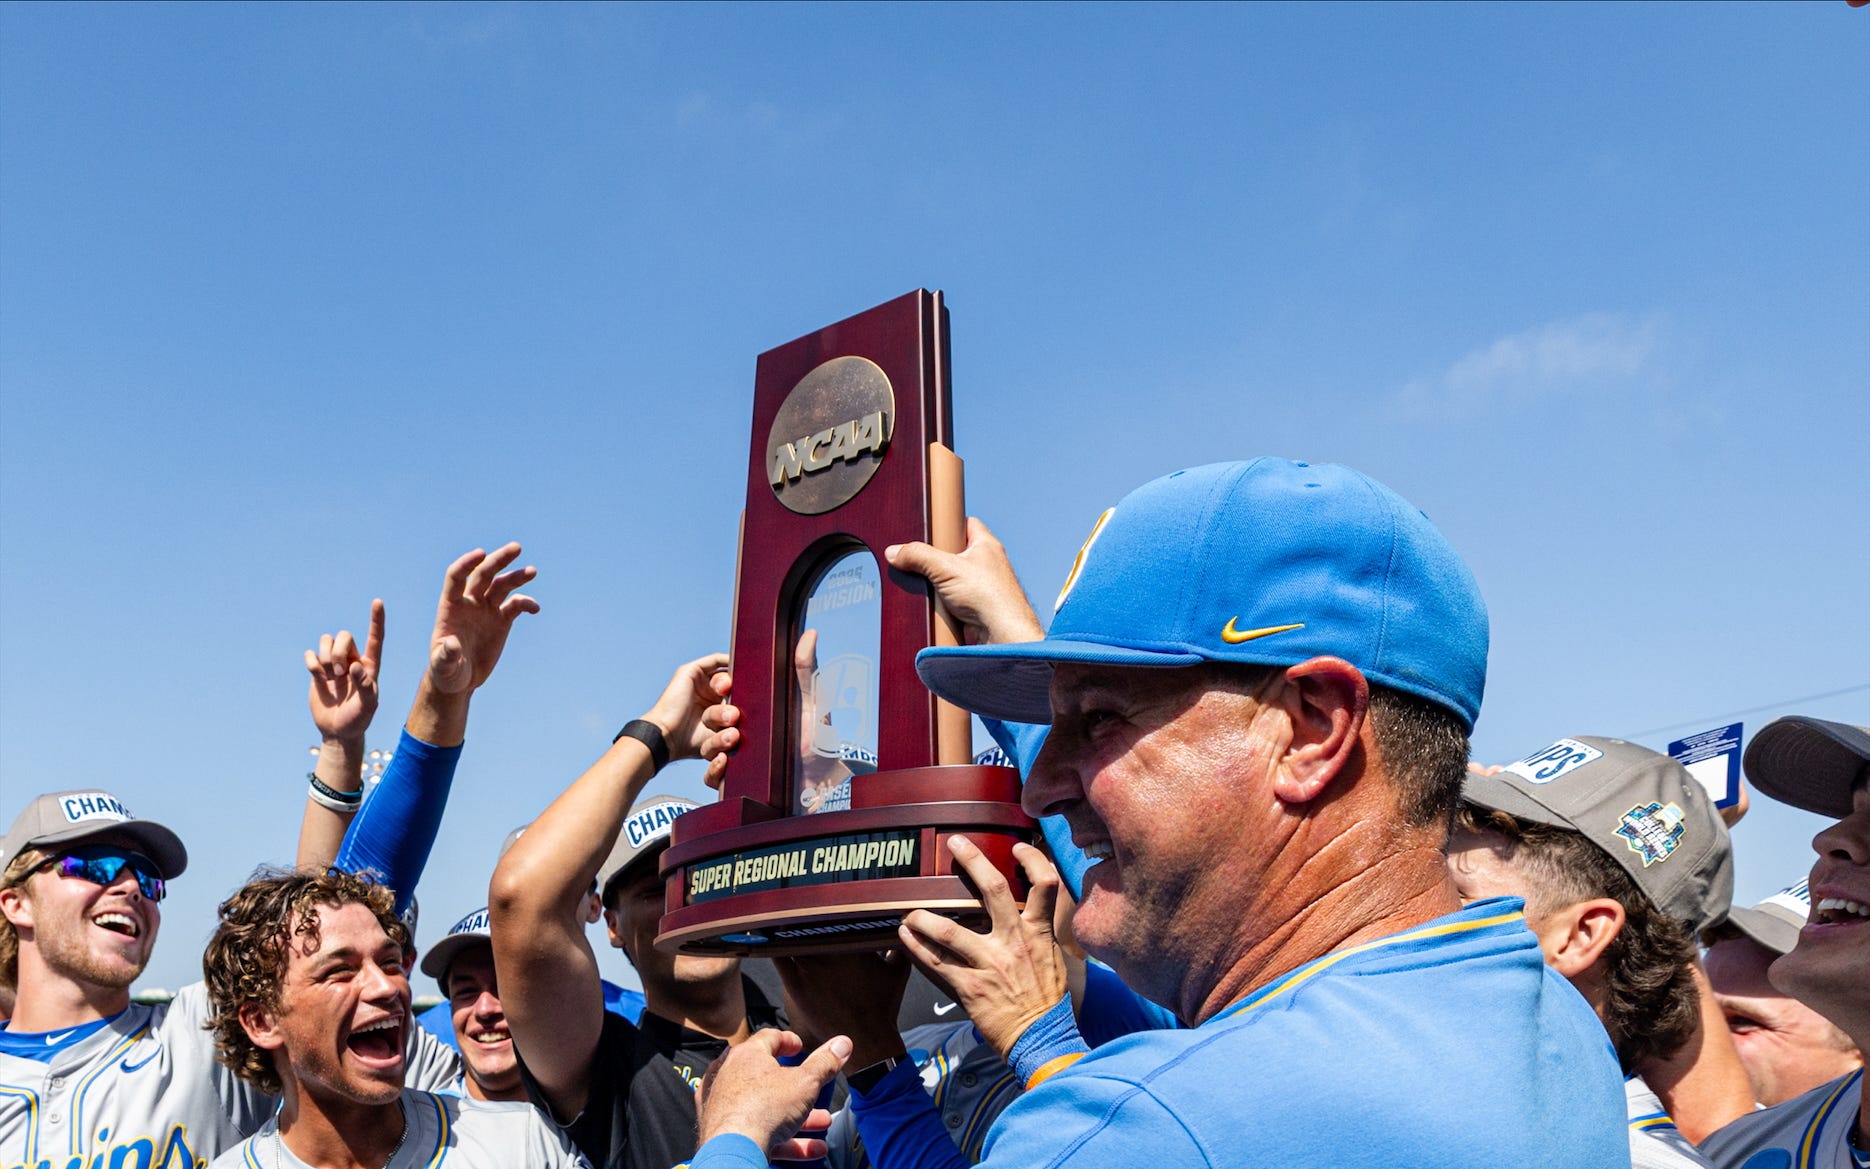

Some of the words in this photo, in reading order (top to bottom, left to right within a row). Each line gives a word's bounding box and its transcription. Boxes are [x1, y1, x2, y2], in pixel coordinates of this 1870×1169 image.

[772, 411, 889, 489] NCAA
[628, 806, 693, 845] CHAM
[690, 864, 731, 896] SUPER
[733, 849, 807, 887] REGIONAL
[811, 838, 915, 874] CHAMPION
